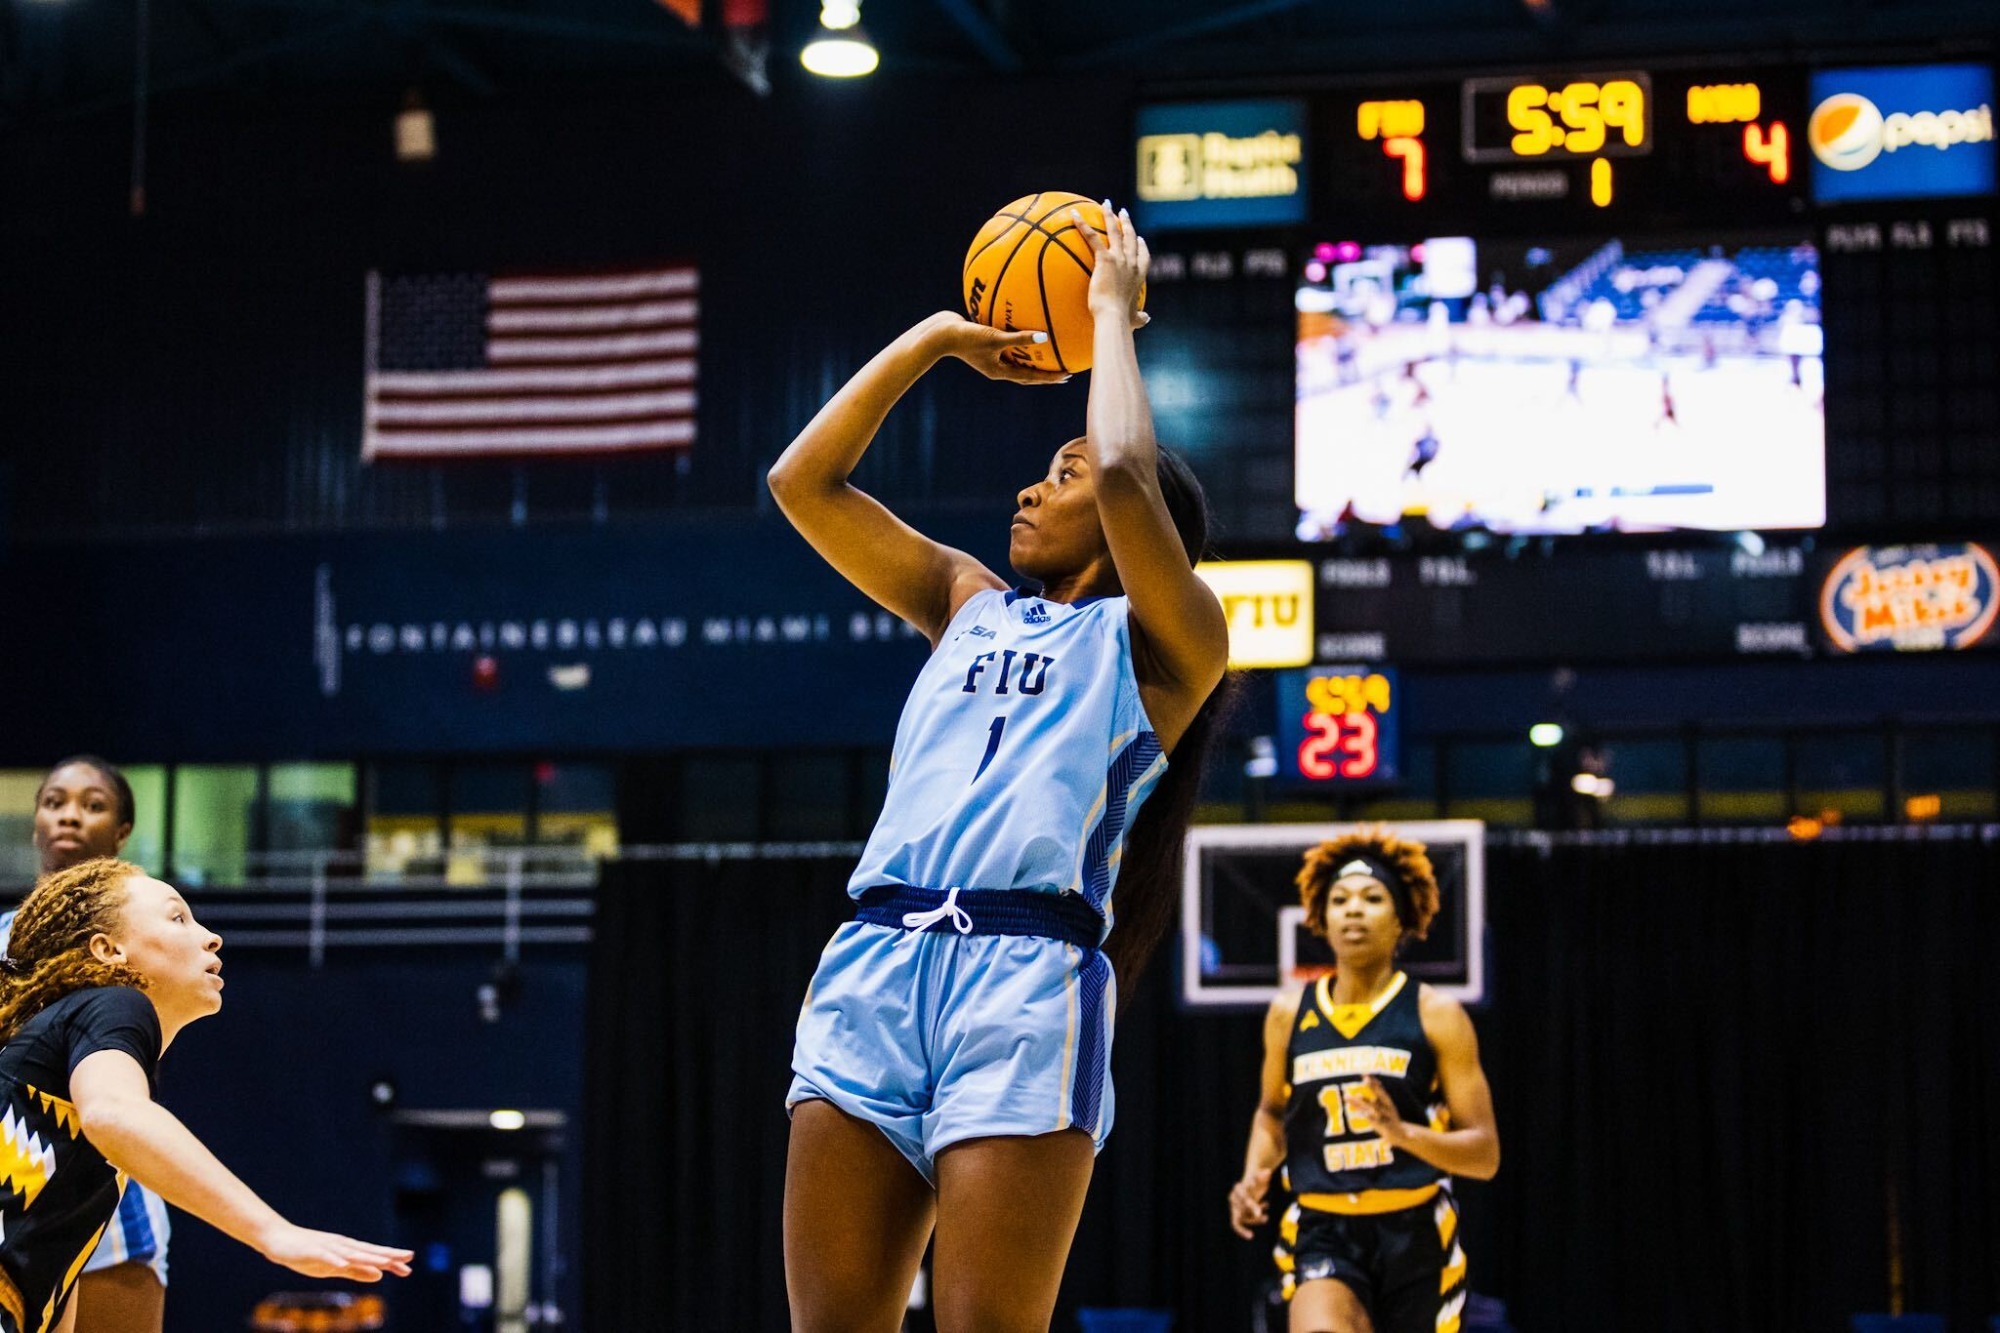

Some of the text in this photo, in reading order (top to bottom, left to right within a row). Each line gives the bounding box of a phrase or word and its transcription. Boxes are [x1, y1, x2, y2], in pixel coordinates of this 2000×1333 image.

[1507, 81, 1644, 156] 5:59
[1884, 103, 1993, 152] pepsi
[1382, 137, 1426, 201] 7
[1591, 158, 1612, 207] 1
[1743, 120, 1788, 184] 4
[1023, 614, 1051, 625] adidas
[962, 650, 1055, 695] FIU
[971, 716, 1006, 785] 1
[1299, 711, 1378, 779] 23
